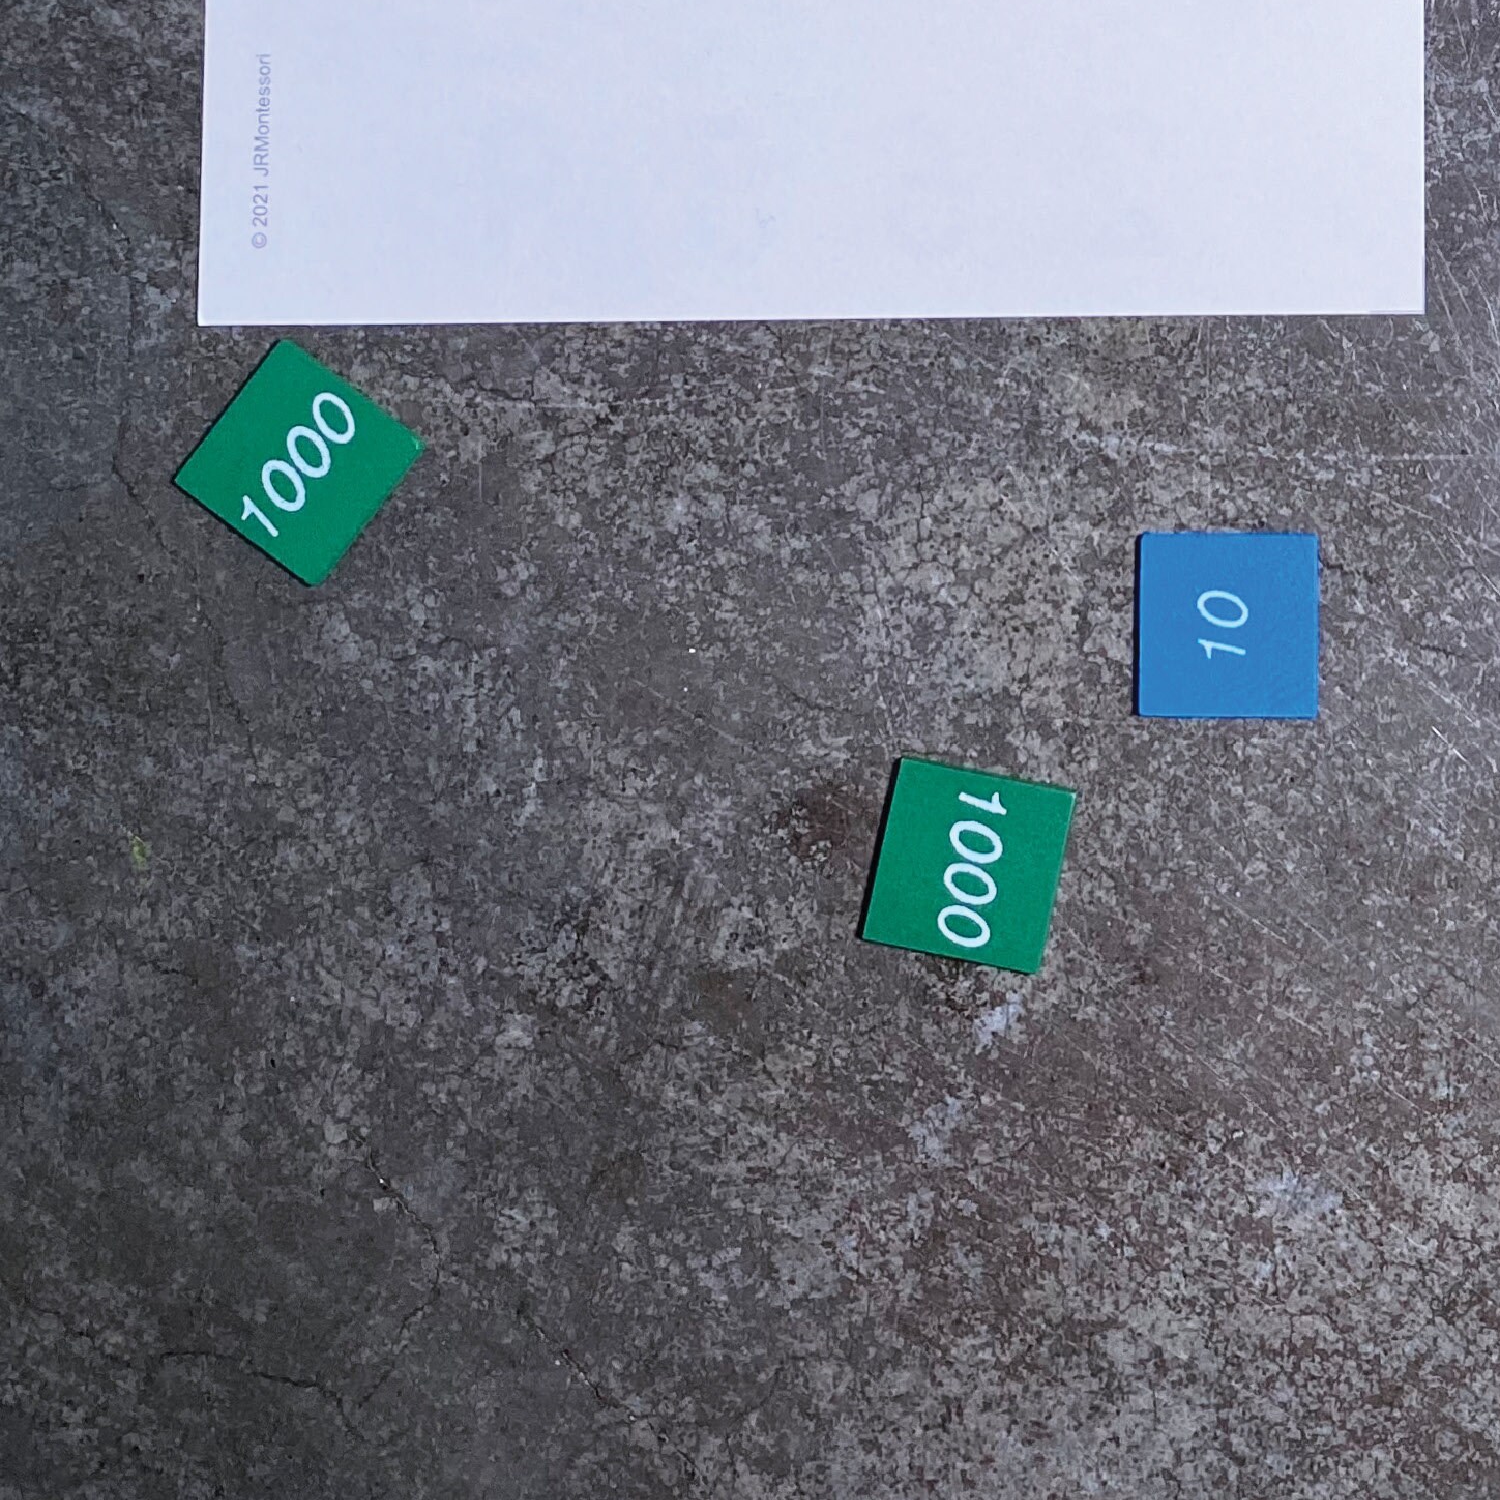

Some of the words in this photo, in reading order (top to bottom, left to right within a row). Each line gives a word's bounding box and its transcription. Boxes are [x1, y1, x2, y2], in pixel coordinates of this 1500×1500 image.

[252, 52, 273, 178] JRMontessori
[251, 183, 270, 228] 2021
[241, 392, 355, 537] 1000
[1195, 588, 1249, 658] 10
[937, 791, 1007, 948] 1000
